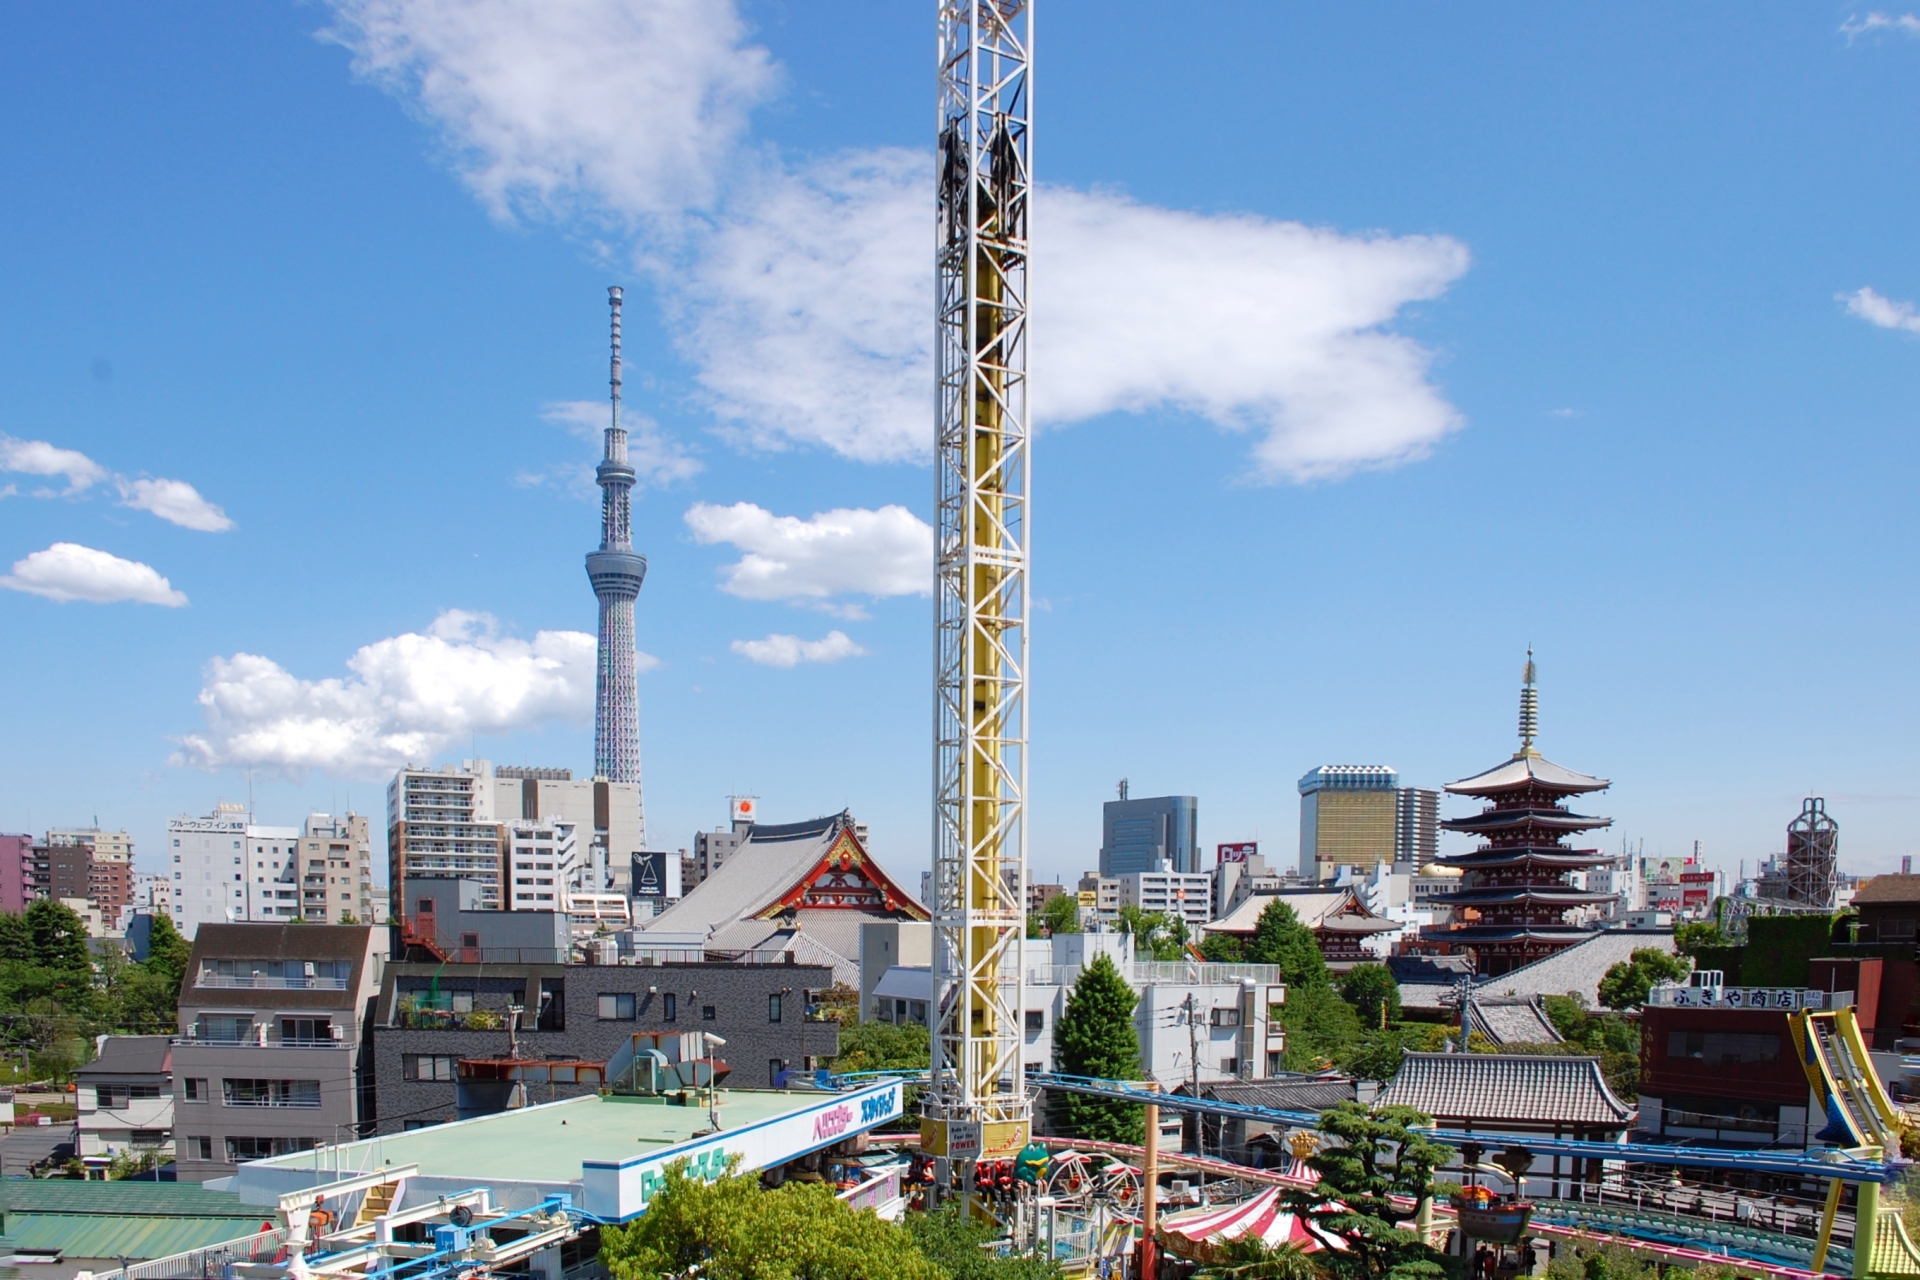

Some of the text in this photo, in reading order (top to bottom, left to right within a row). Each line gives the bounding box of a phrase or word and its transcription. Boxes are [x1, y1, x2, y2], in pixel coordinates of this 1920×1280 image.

[1674, 989, 1793, 1007] ふきや商店
[951, 1140, 975, 1149] POWER
